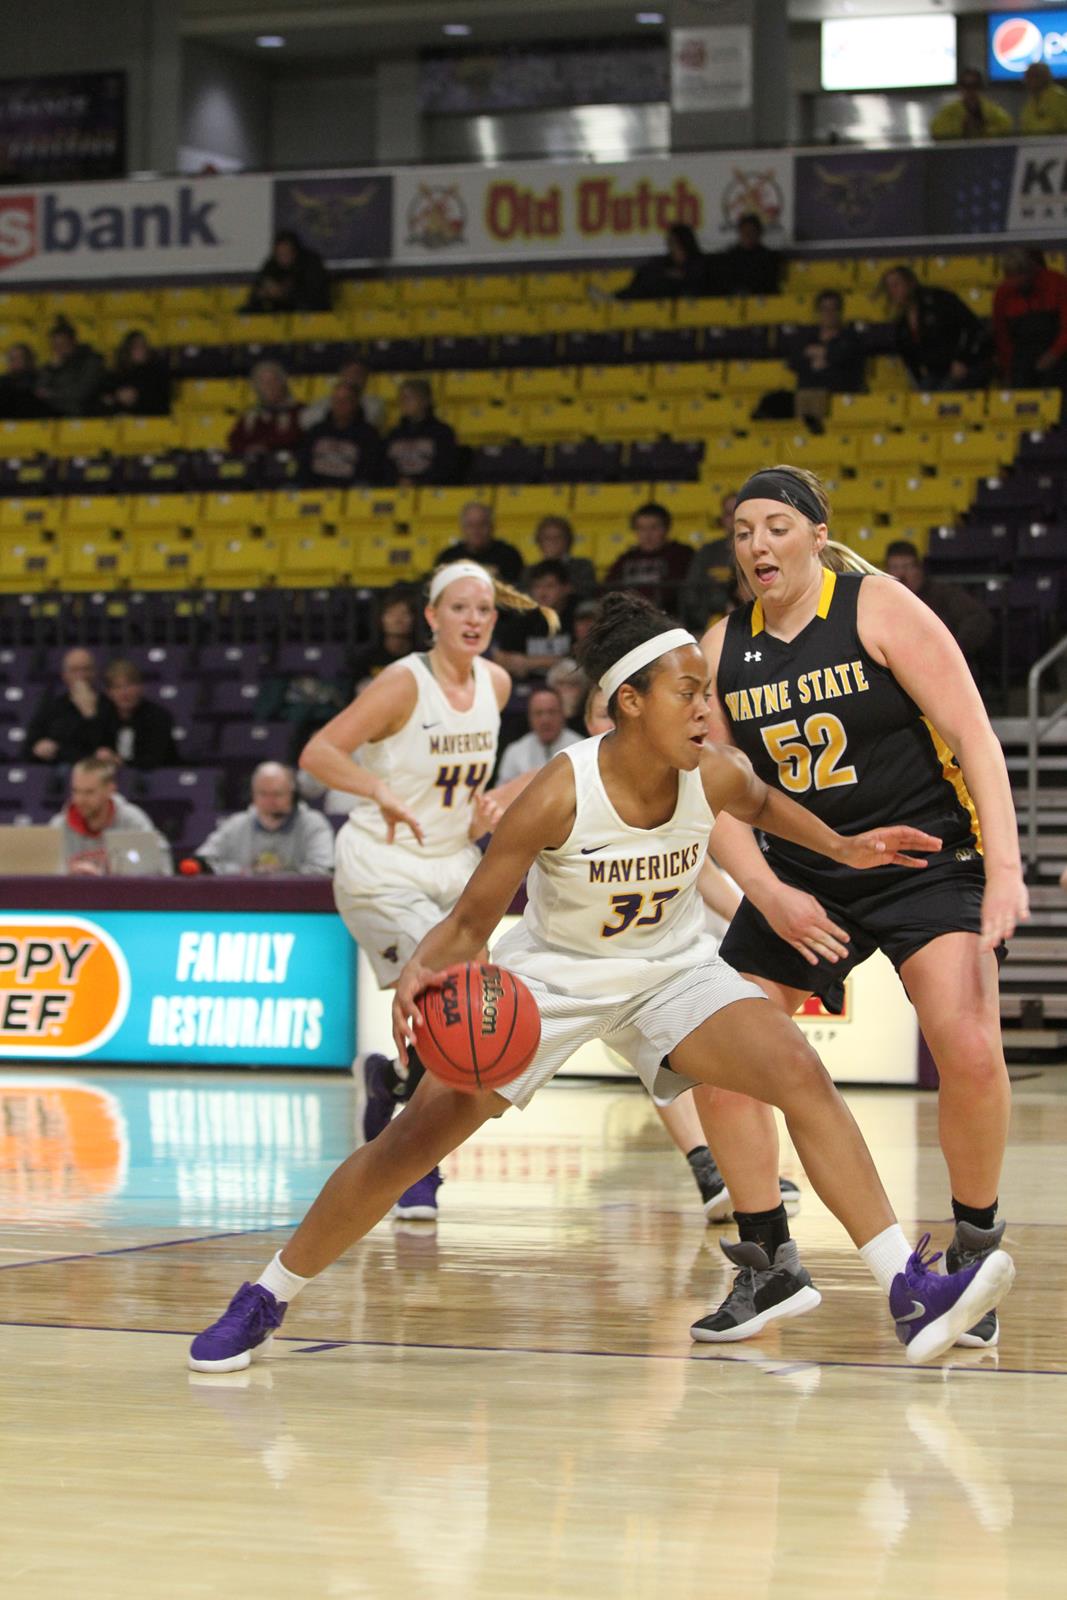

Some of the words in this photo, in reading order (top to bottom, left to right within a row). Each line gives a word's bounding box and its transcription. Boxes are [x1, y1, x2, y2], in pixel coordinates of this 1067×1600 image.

[485, 179, 562, 243] Old
[575, 174, 704, 236] Dutch
[725, 680, 792, 722] WAYNE
[797, 660, 869, 704] STATE
[760, 712, 858, 793] 52
[434, 763, 488, 811] 44
[589, 843, 699, 883] MAVERICKS
[176, 931, 296, 984] FAMILY
[148, 995, 324, 1050] RESTAURANTS
